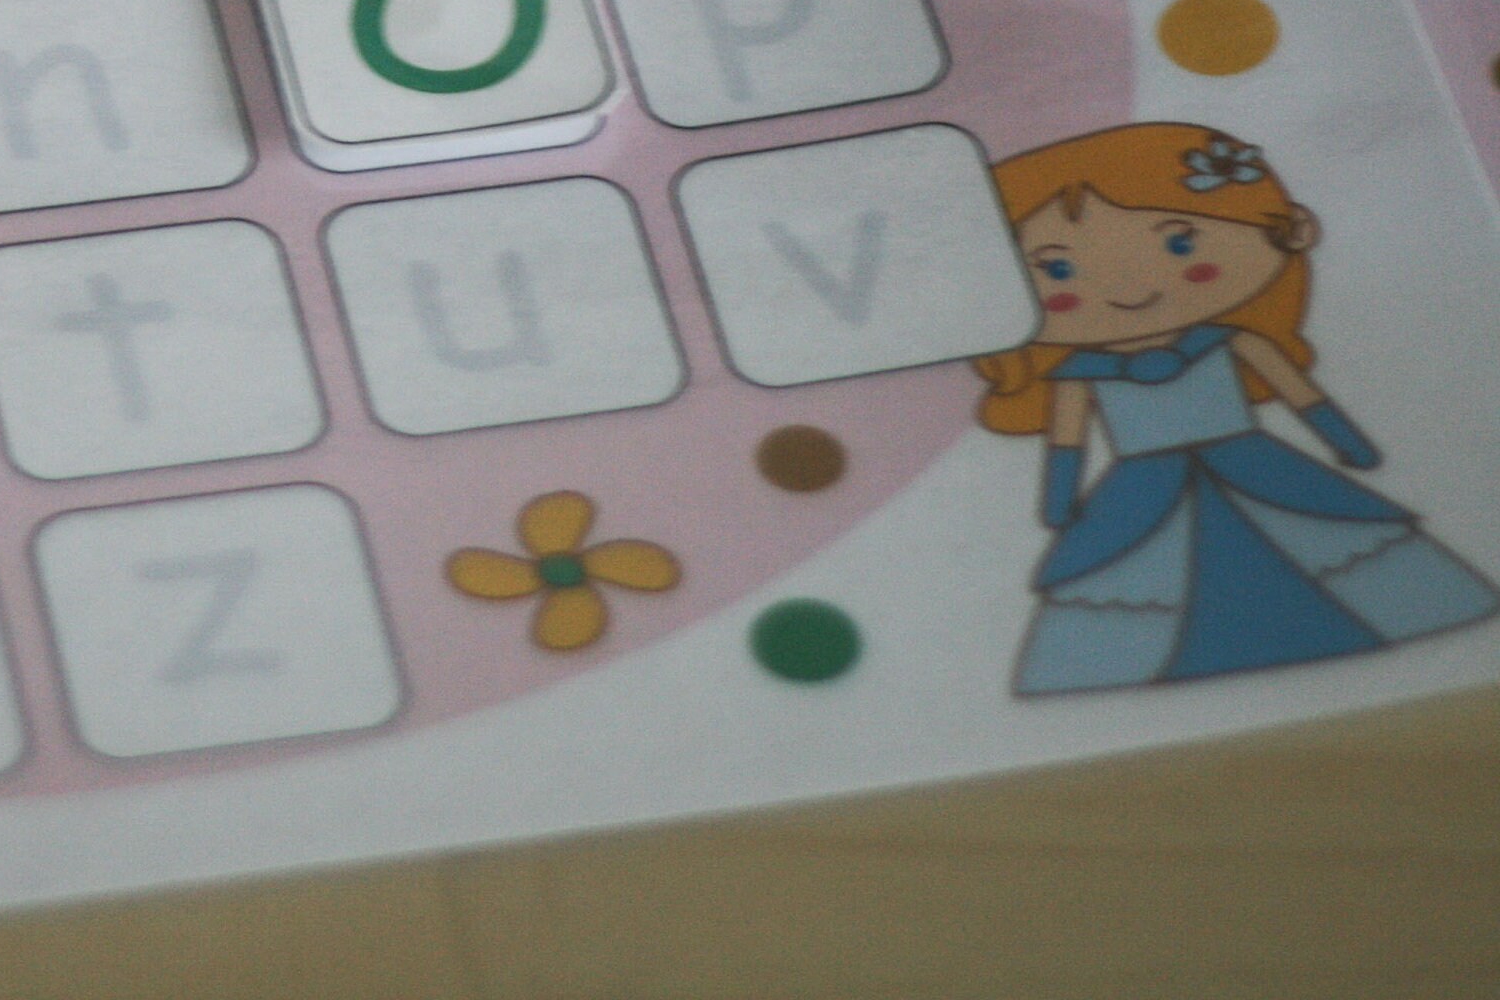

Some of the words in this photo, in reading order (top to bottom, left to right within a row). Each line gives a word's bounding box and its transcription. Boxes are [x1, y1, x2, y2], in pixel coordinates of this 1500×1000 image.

[55, 270, 172, 424] t
[406, 247, 551, 369] u
[759, 209, 889, 328] v
